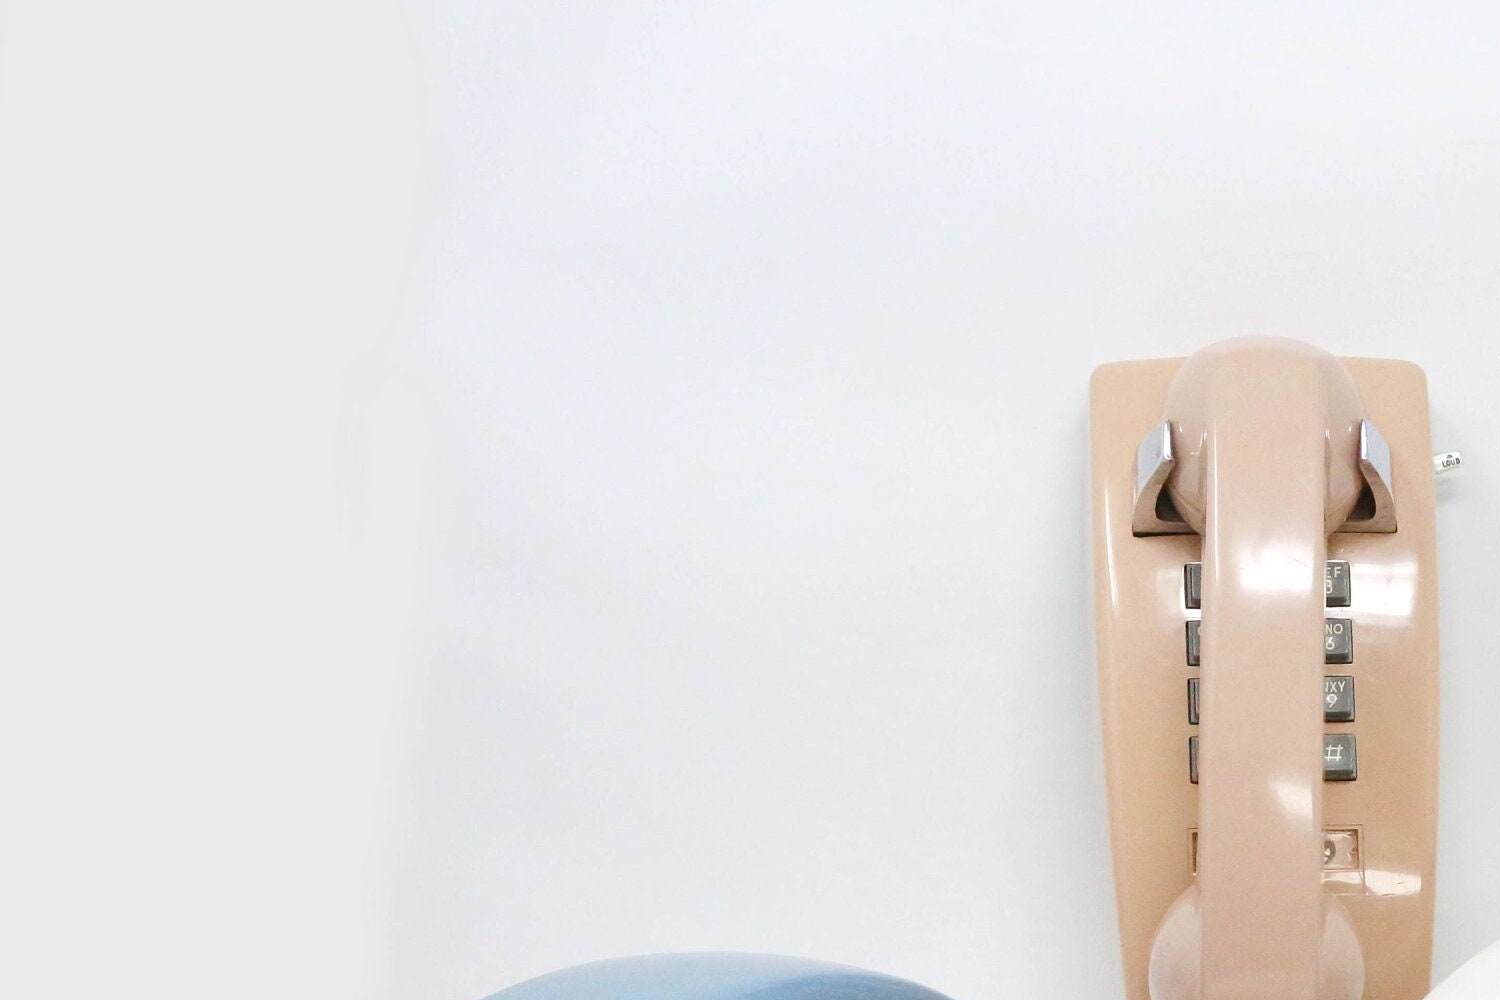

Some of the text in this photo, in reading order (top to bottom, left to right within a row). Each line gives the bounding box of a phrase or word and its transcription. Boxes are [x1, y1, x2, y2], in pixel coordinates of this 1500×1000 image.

[1441, 457, 1461, 468] LOUD
[1325, 623, 1344, 635] NO
[1325, 636, 1335, 651] 6
[1324, 680, 1346, 693] XY
[1327, 693, 1338, 708] 9
